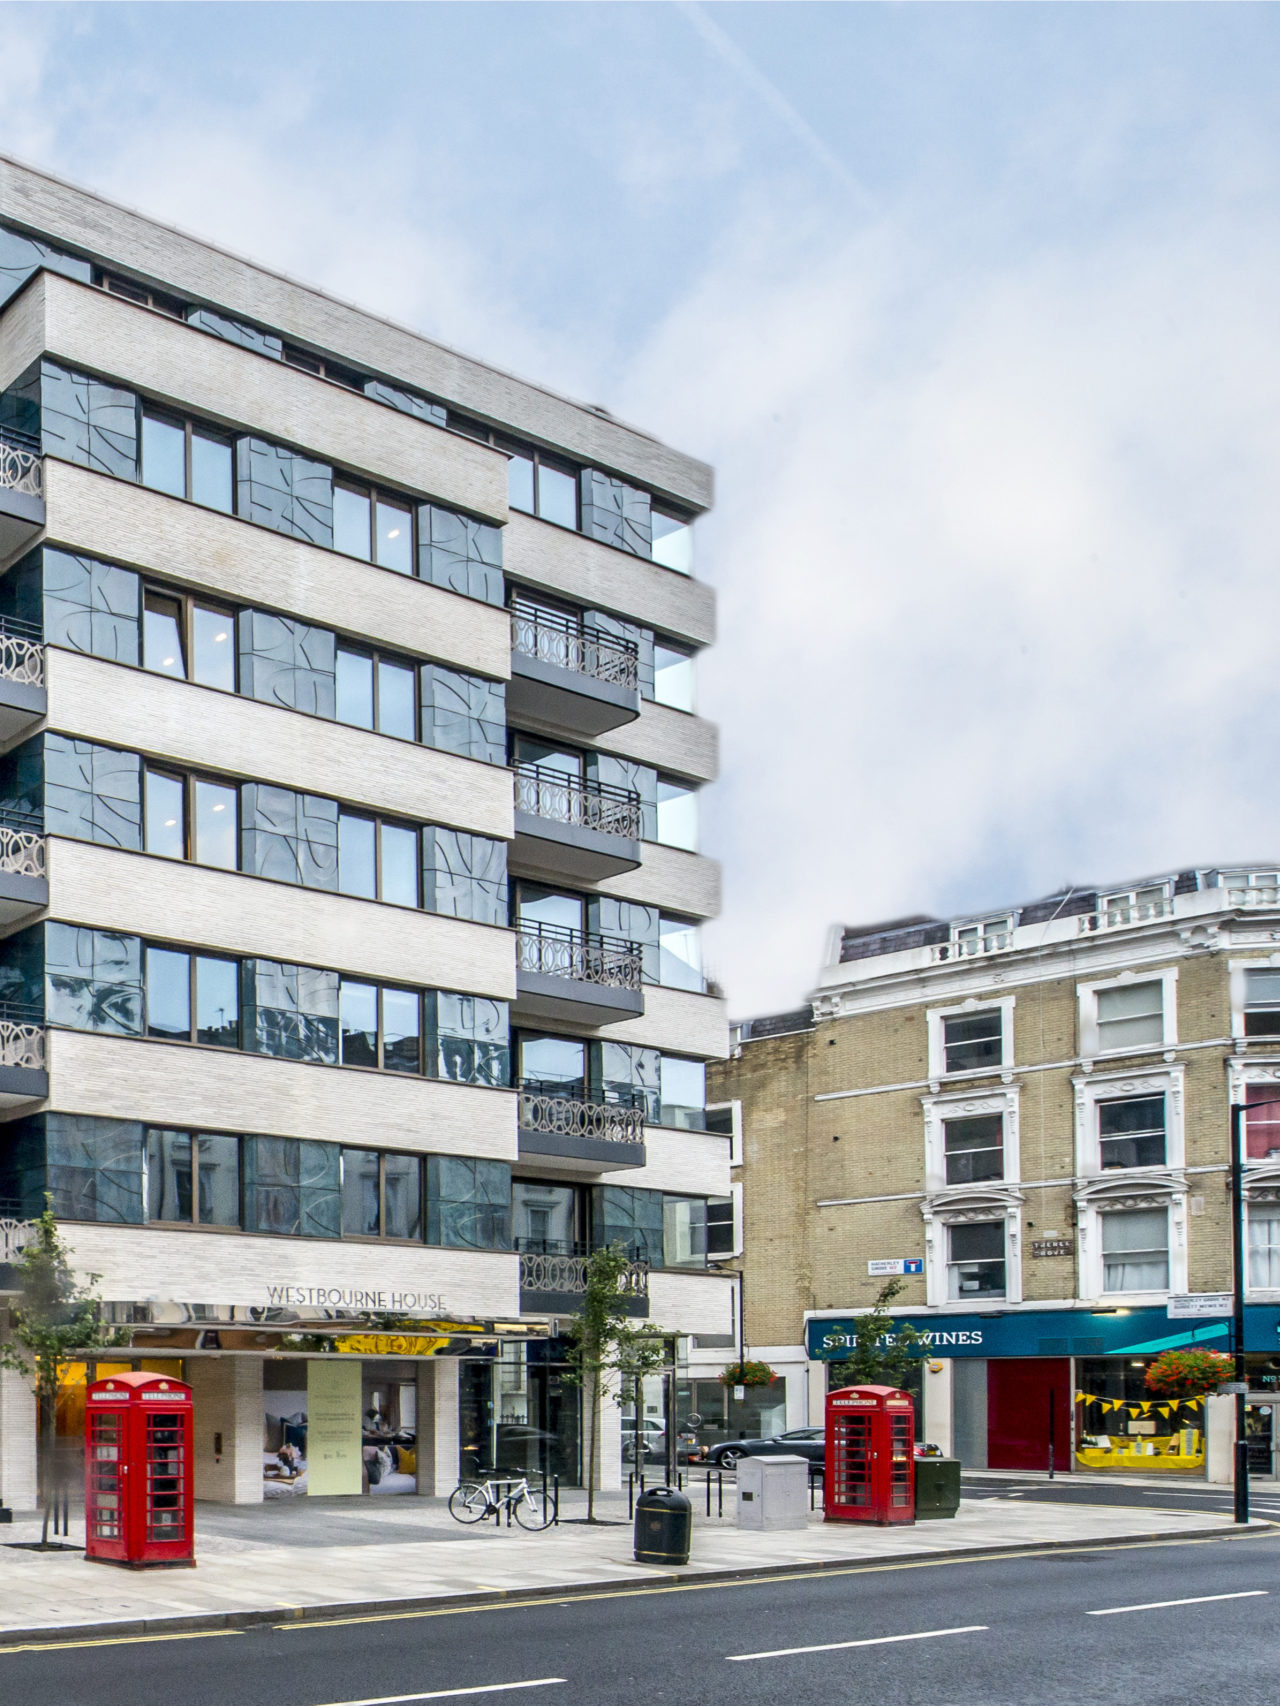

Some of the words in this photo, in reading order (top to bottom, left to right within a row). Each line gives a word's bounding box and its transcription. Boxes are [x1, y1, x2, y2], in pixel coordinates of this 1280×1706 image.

[266, 1286, 387, 1308] WESTBOURNE
[391, 1292, 447, 1311] HOUSE
[916, 1331, 983, 1345] WINES
[93, 1392, 129, 1400] TELEPHONE
